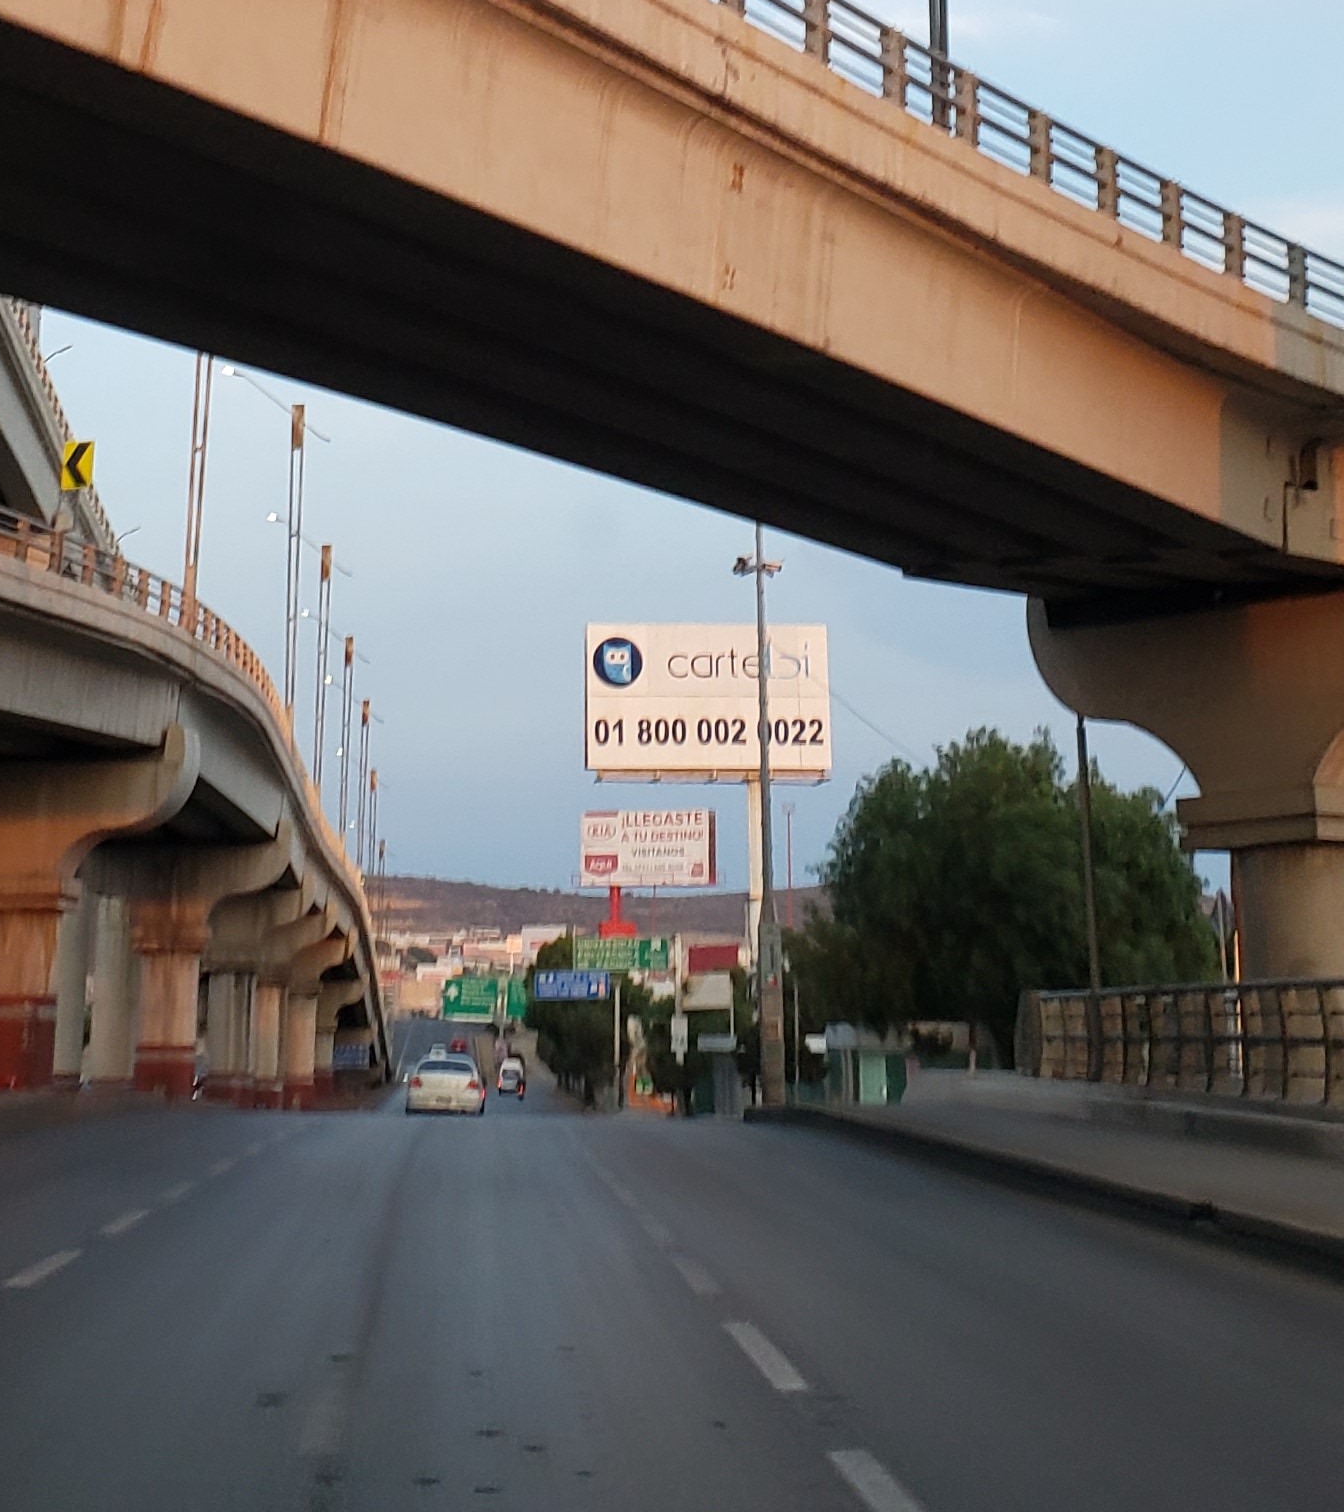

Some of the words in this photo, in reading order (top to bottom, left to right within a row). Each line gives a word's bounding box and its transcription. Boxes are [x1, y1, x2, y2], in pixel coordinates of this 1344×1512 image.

[594, 718, 624, 745] 01
[637, 718, 687, 745] 800
[697, 718, 747, 745] 002
